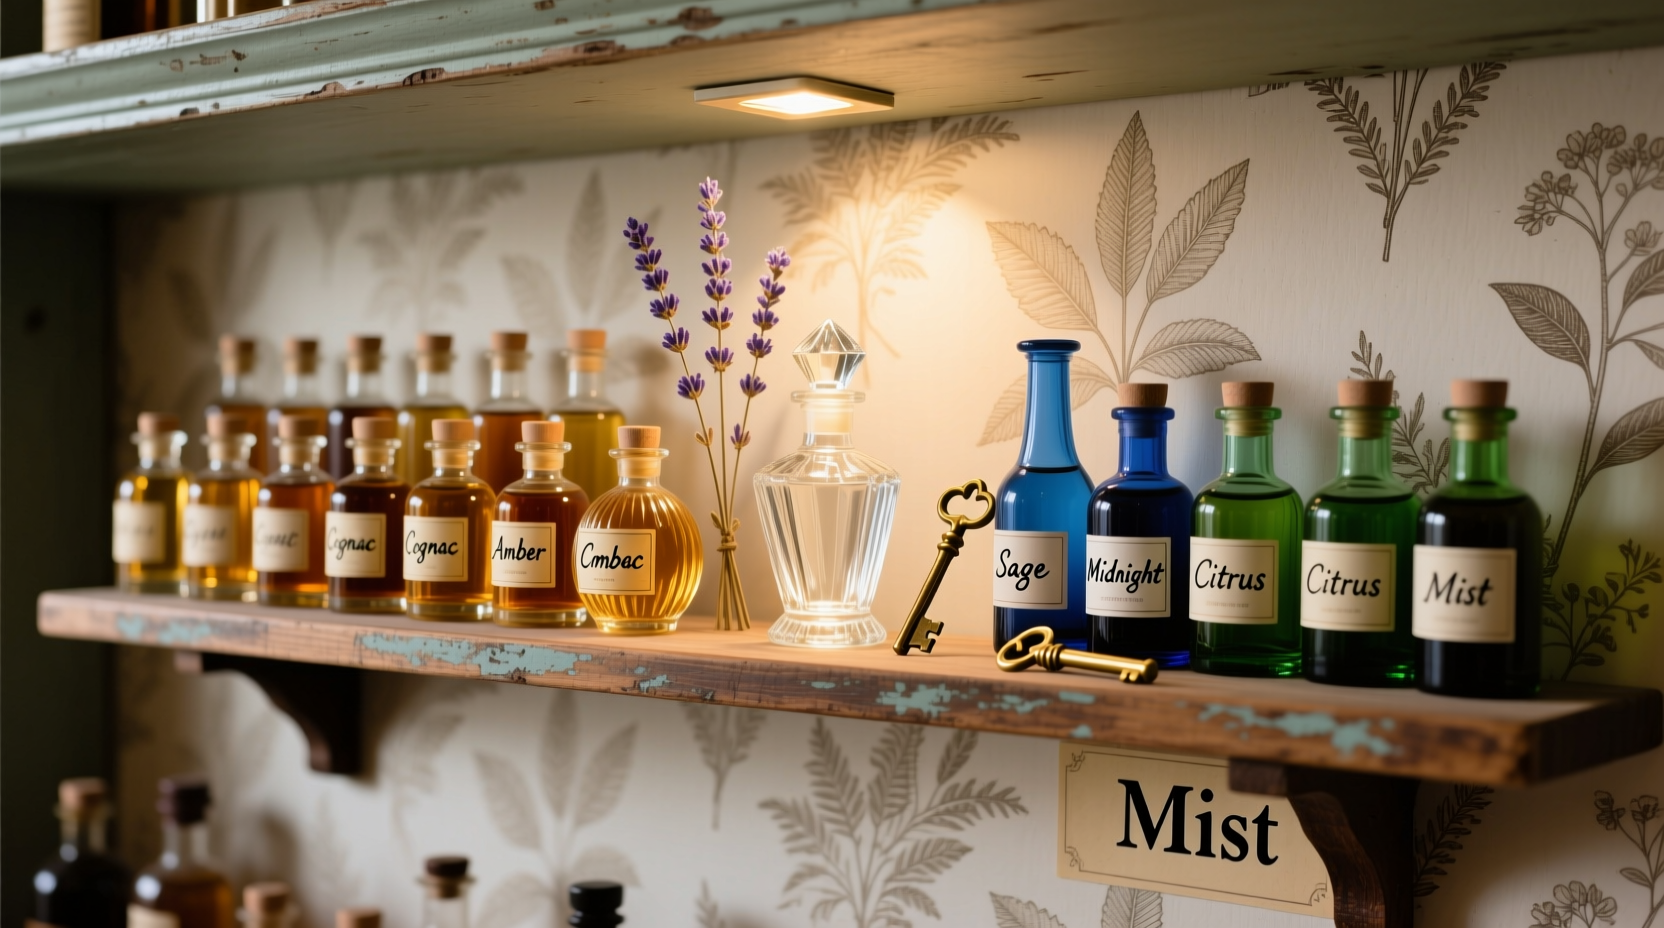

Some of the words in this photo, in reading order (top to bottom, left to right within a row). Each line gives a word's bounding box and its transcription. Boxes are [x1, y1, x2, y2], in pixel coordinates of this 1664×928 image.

[327, 525, 377, 561] Cognac
[405, 530, 459, 564] Cognac
[491, 535, 547, 562] Amber
[995, 548, 1050, 592] Sage
[1087, 557, 1165, 594] Midnight
[1194, 558, 1267, 592] Citrus
[1306, 562, 1382, 598] Citrus
[1423, 571, 1495, 607] Mist
[1116, 778, 1279, 866] Mist
